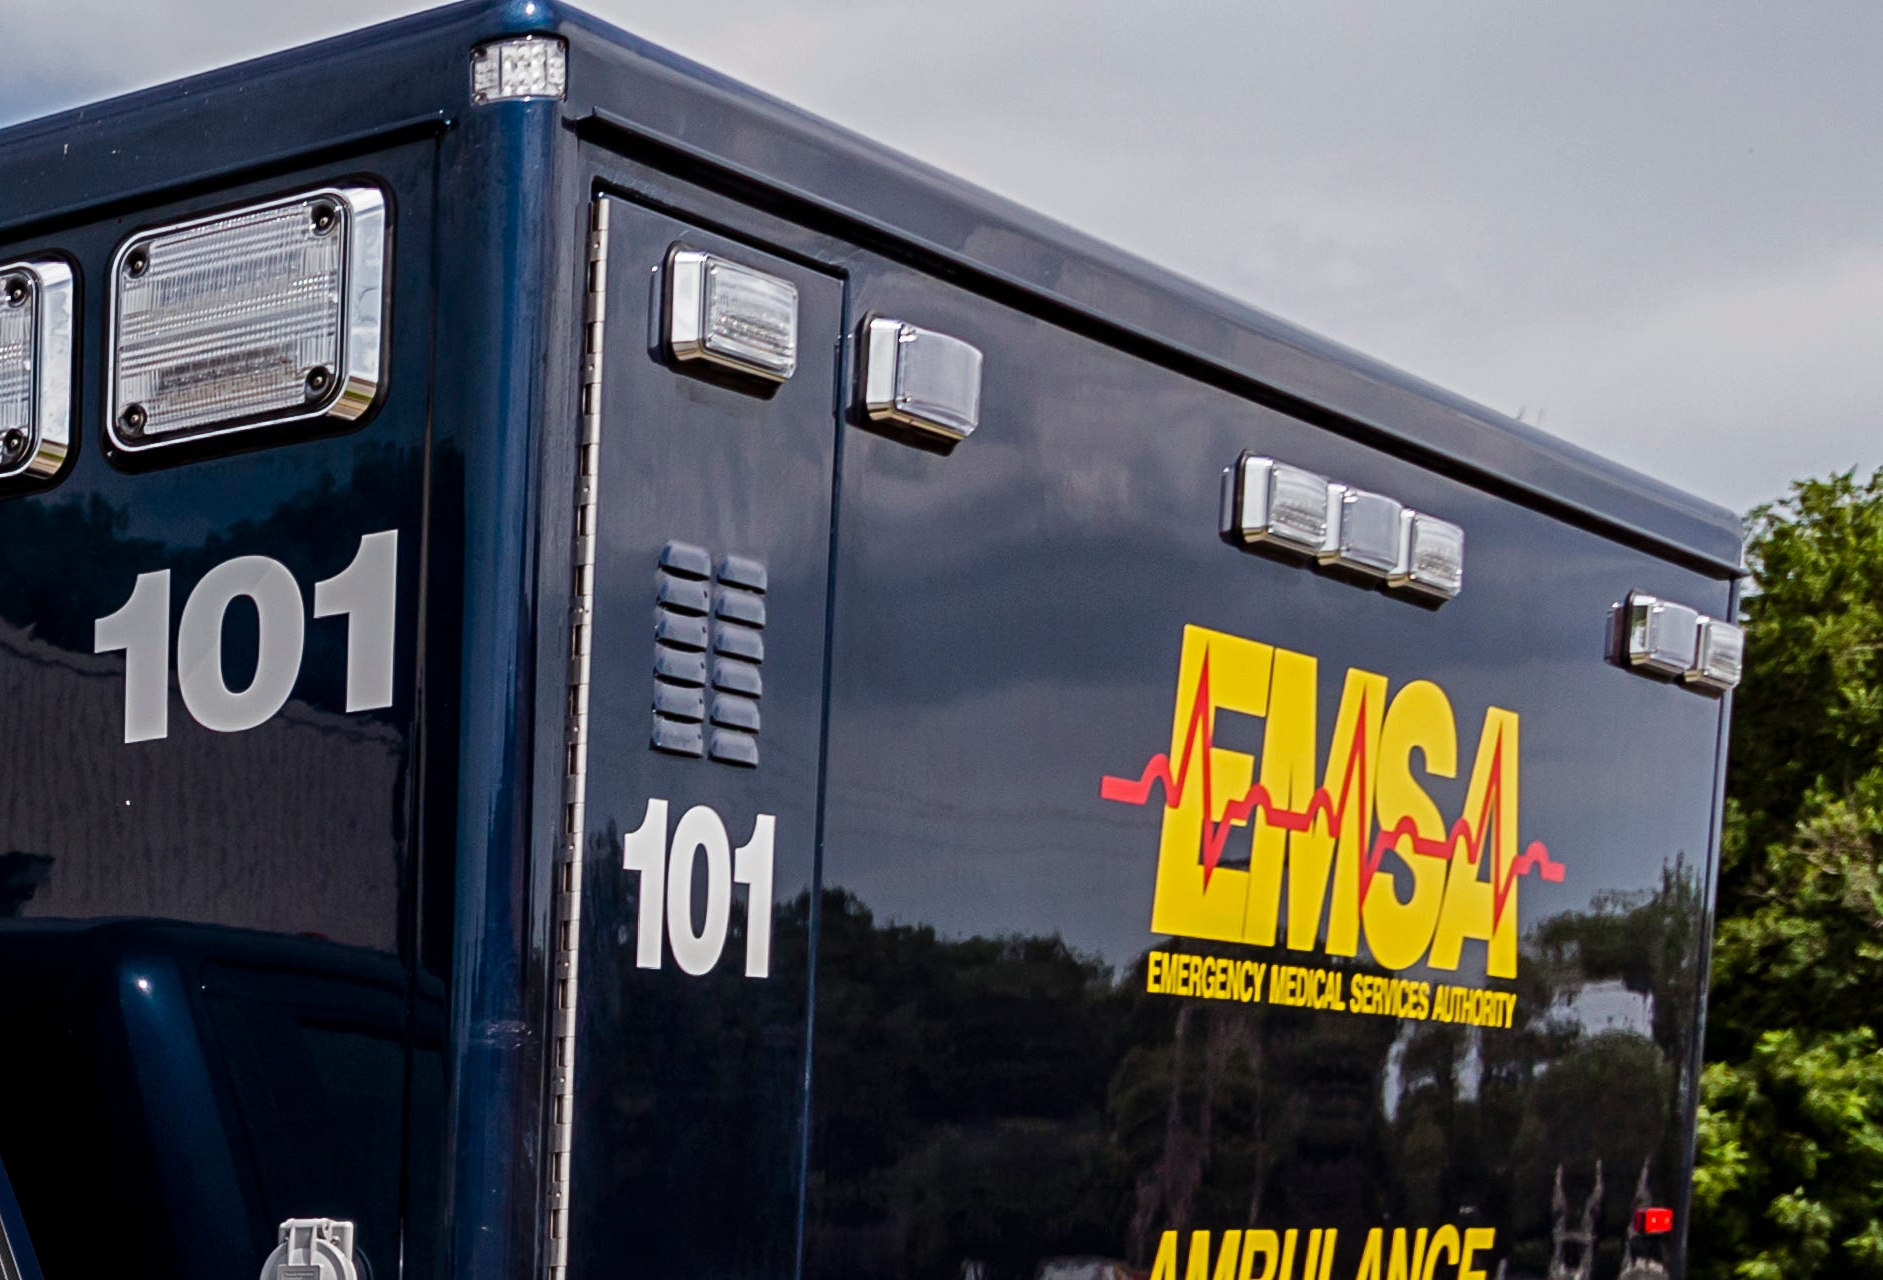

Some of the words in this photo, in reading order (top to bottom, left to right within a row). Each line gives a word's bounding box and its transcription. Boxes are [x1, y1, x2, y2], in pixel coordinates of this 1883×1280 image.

[94, 529, 398, 744] 101
[623, 798, 776, 979] 101
[1151, 624, 1519, 978] EMSA
[1147, 951, 1267, 1004] EMERGENCY
[1269, 964, 1346, 1012] MEDICAL
[1349, 973, 1430, 1021] SERVICES
[1431, 983, 1517, 1030] AUTHORITY
